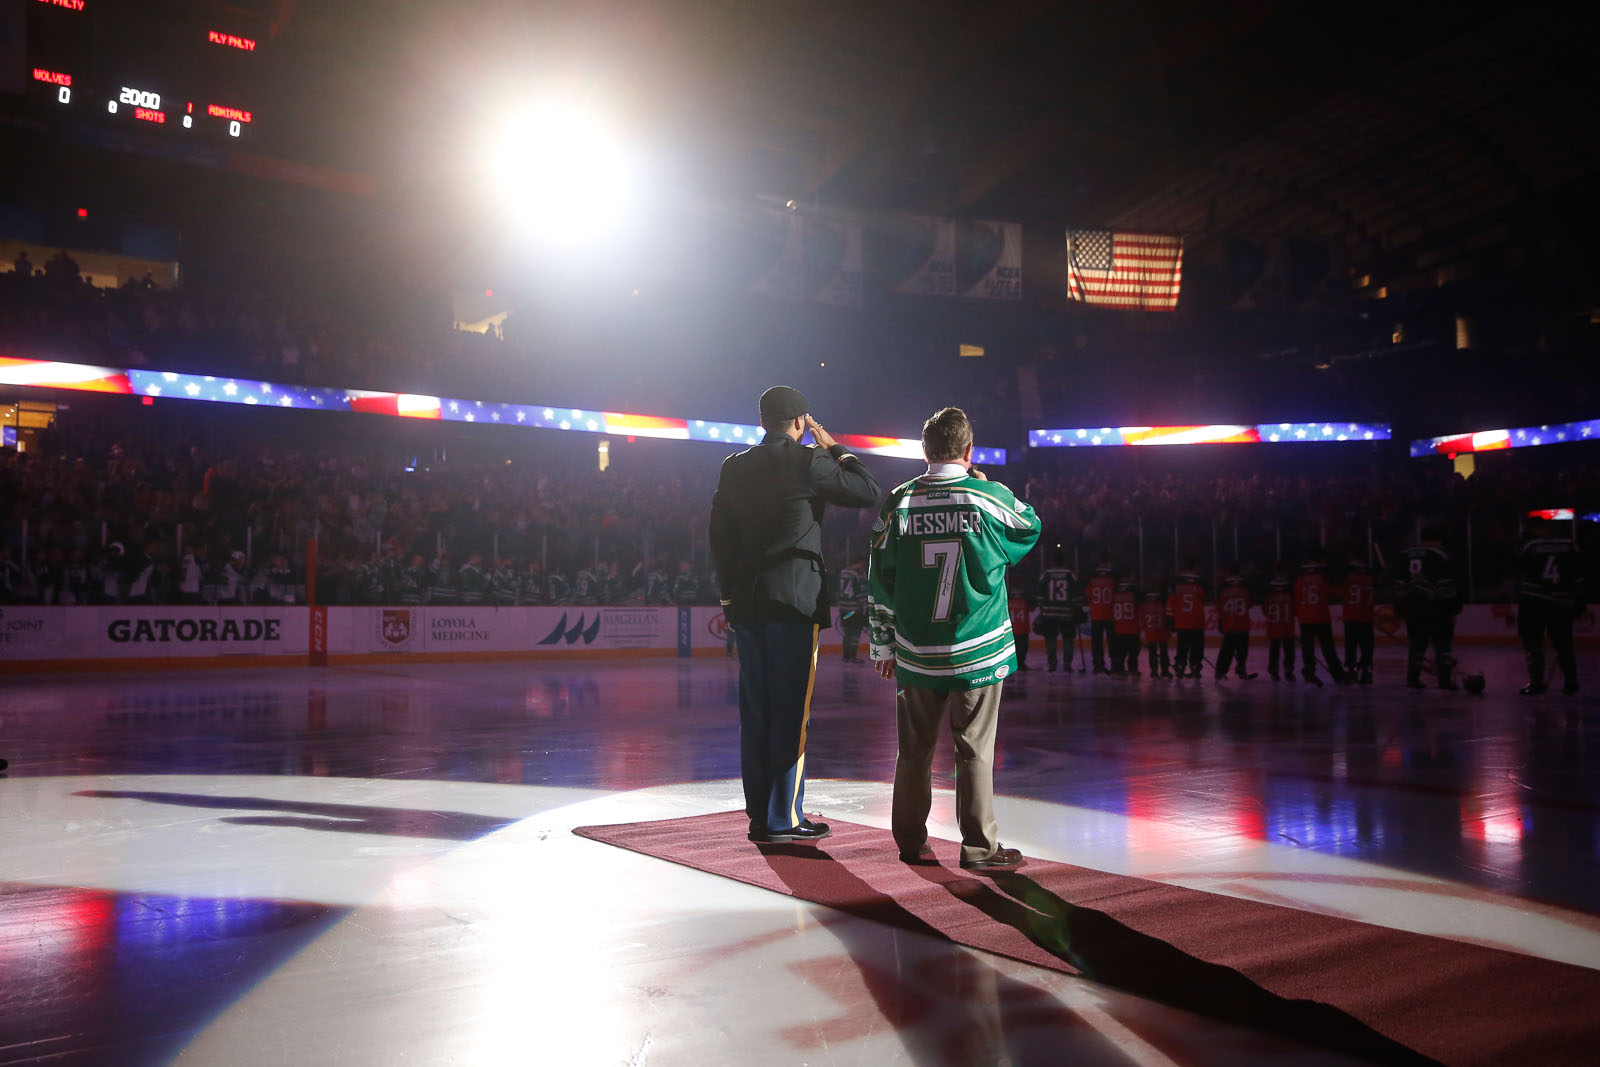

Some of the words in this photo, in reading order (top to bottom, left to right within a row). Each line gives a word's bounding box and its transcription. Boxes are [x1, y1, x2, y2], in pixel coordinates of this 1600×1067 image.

[208, 30, 227, 44] PLY
[227, 35, 256, 51] PNLTY
[33, 68, 72, 86] WOLVES
[58, 86, 70, 104] 0
[108, 100, 118, 113] 0
[135, 107, 166, 123] SHOTS
[208, 104, 252, 123] ADMIRALS
[230, 120, 241, 137] 0
[898, 511, 982, 537] MESSMER
[1541, 554, 1560, 585] 4
[921, 539, 962, 622] 7
[1048, 578, 1068, 601] 13
[1091, 587, 1112, 604] 90
[1182, 594, 1194, 612] 5
[1222, 598, 1247, 616] 48
[1268, 605, 1290, 623] 91
[7, 620, 45, 631] JOINT
[431, 617, 476, 628] LOYOLA
[603, 613, 659, 625] MAGELLAN
[108, 618, 281, 642] GATORADE
[431, 631, 490, 641] MEDICINE
